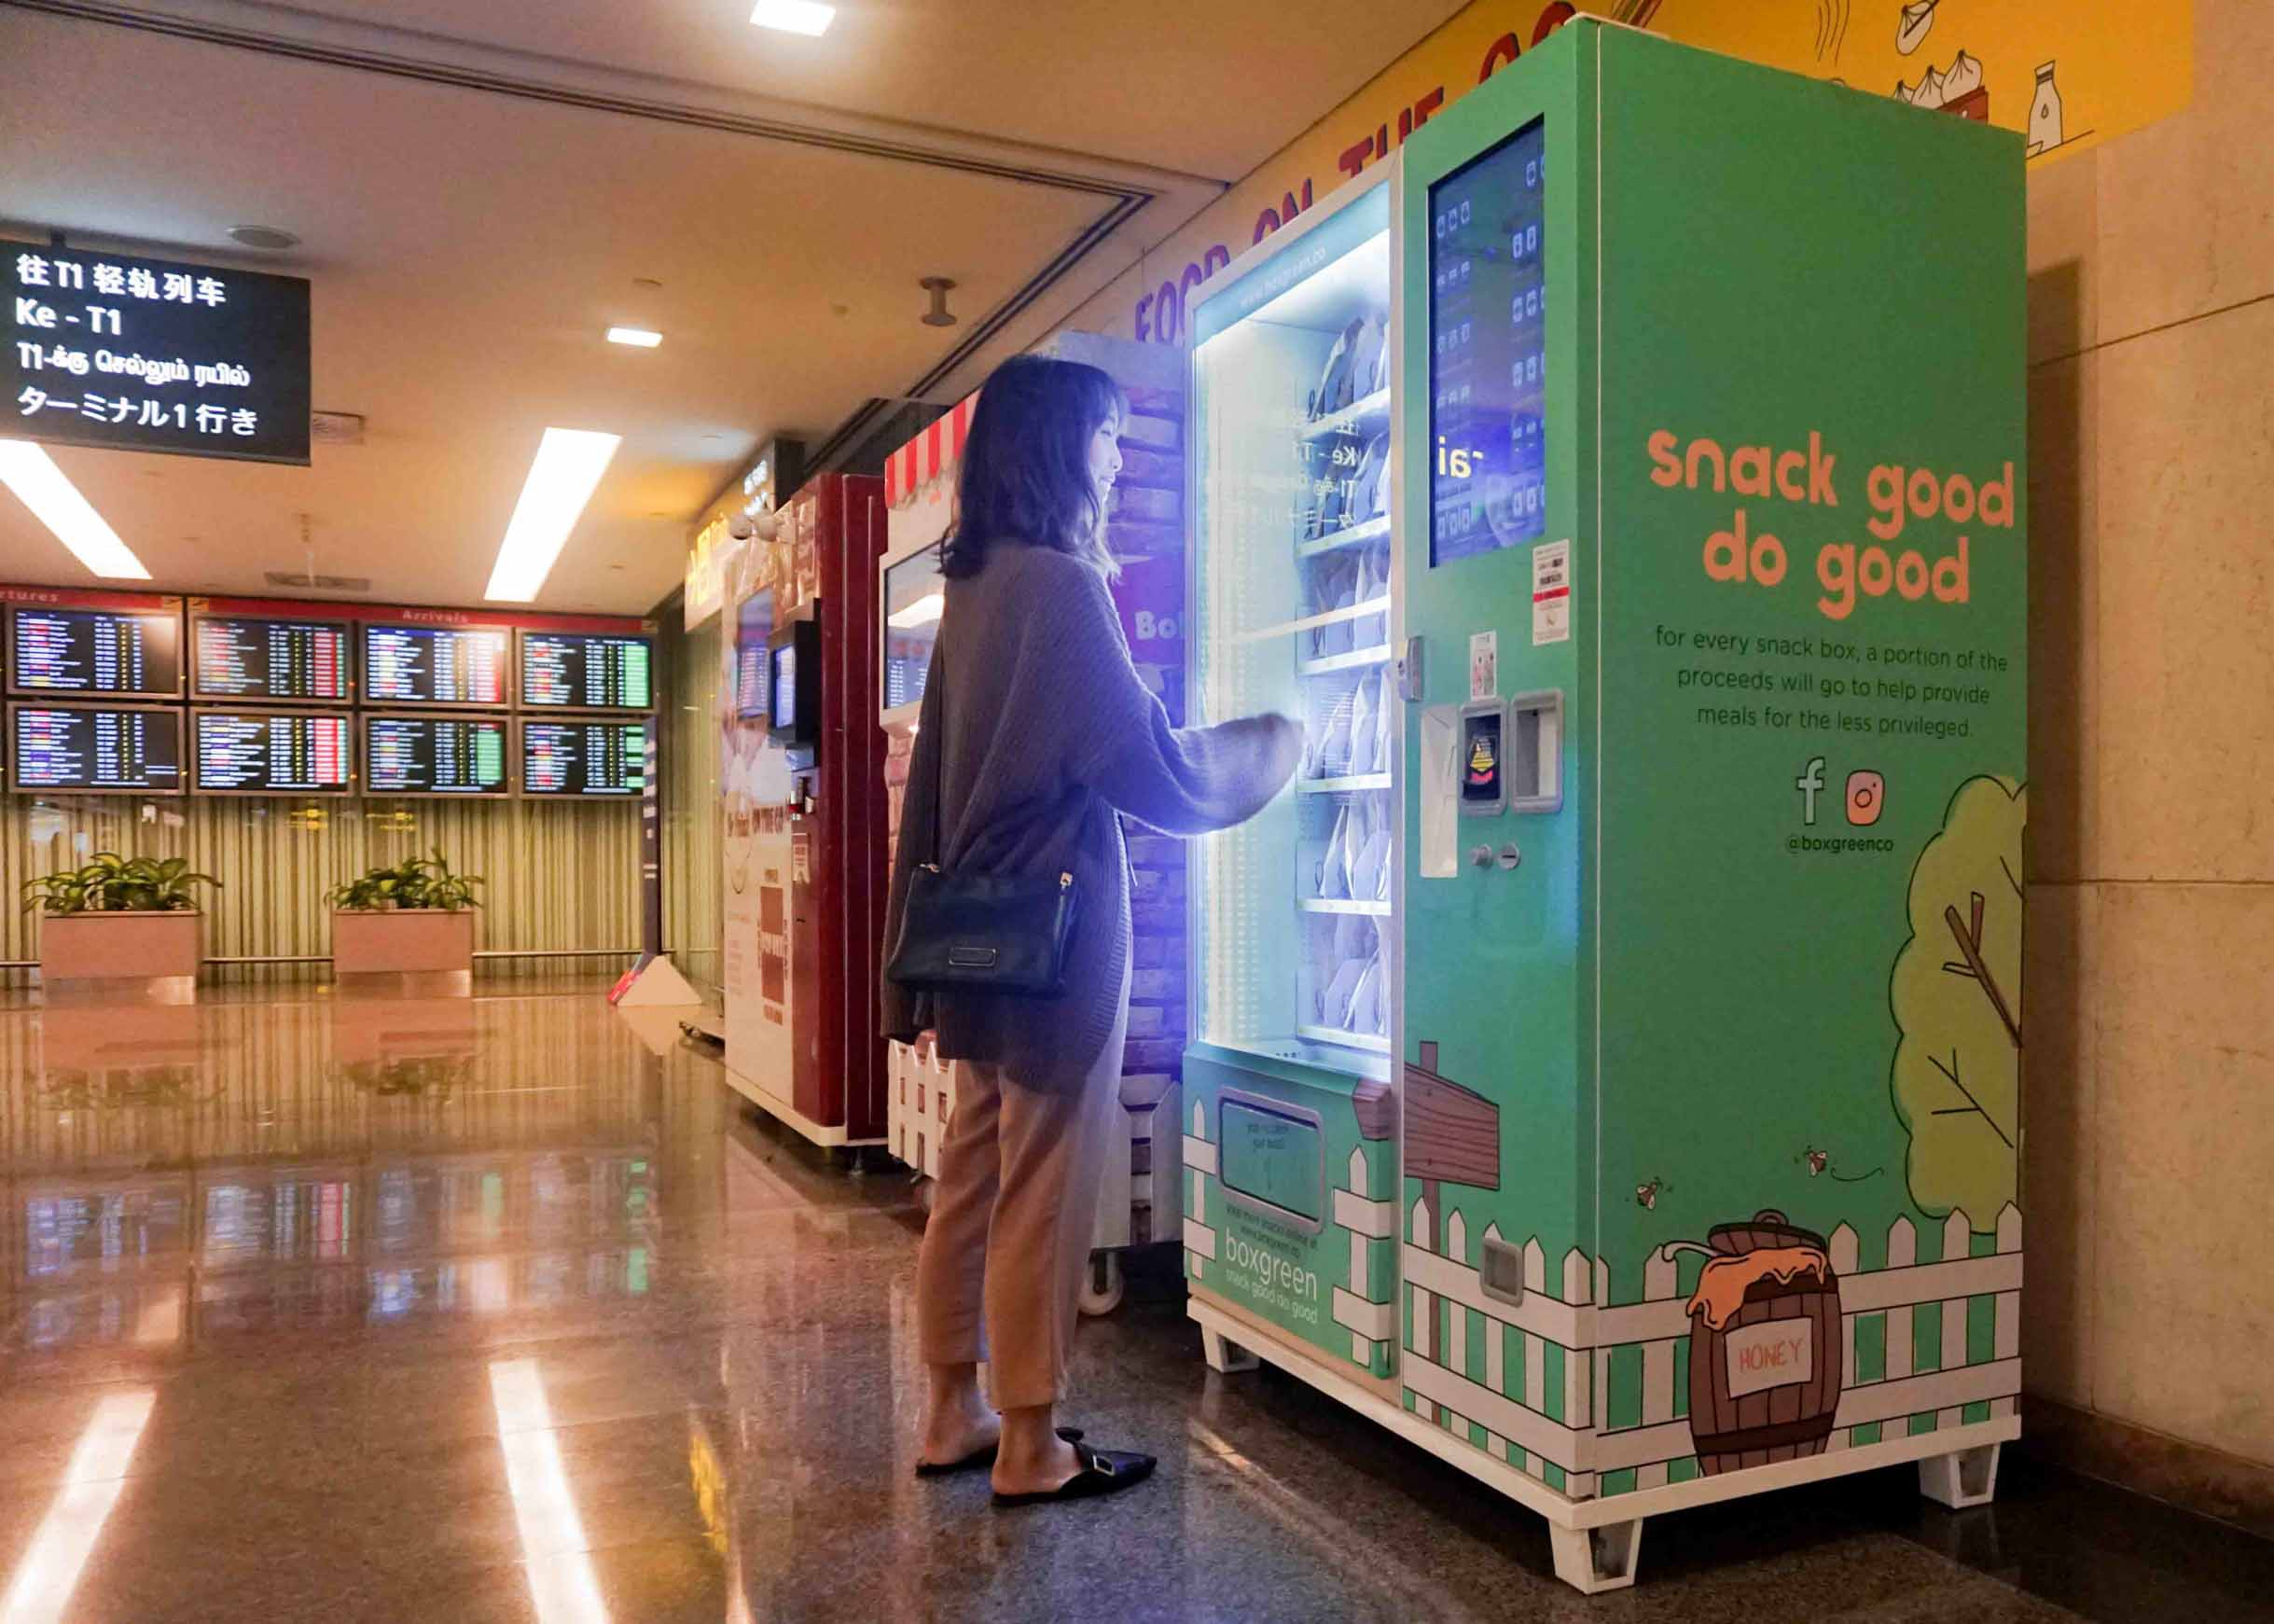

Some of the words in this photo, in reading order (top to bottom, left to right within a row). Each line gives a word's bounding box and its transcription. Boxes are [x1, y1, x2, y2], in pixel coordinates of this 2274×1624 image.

[15, 297, 58, 328] Ke
[85, 305, 122, 336] T1
[1647, 428, 1838, 507] snack
[1866, 461, 2015, 540] good
[1703, 507, 1787, 587] do
[1816, 536, 1970, 620] good
[402, 609, 468, 624] Arrivals
[1134, 611, 1185, 641] Bo
[1656, 624, 1686, 647] for
[1693, 632, 1749, 656] every
[1756, 633, 1813, 658] snack
[1820, 640, 1861, 663] box,
[1866, 647, 1878, 662] a
[1883, 645, 1951, 668] portion
[1956, 649, 1975, 669] of
[1978, 651, 2008, 673] the
[1678, 668, 1773, 692] proceeds
[1781, 673, 1813, 694] will
[1820, 680, 1845, 698] go
[1851, 678, 1871, 698] to
[1876, 680, 1917, 702] help
[1922, 683, 1990, 705] provide
[1697, 704, 1756, 727] meals
[1764, 706, 1792, 728] for
[1799, 708, 1830, 729] the
[1837, 711, 1872, 732] less
[1788, 834, 1894, 854] @boxgreenco
[1226, 1225, 1317, 1302] boxgreen
[1739, 1338, 1804, 1371] HONEY
